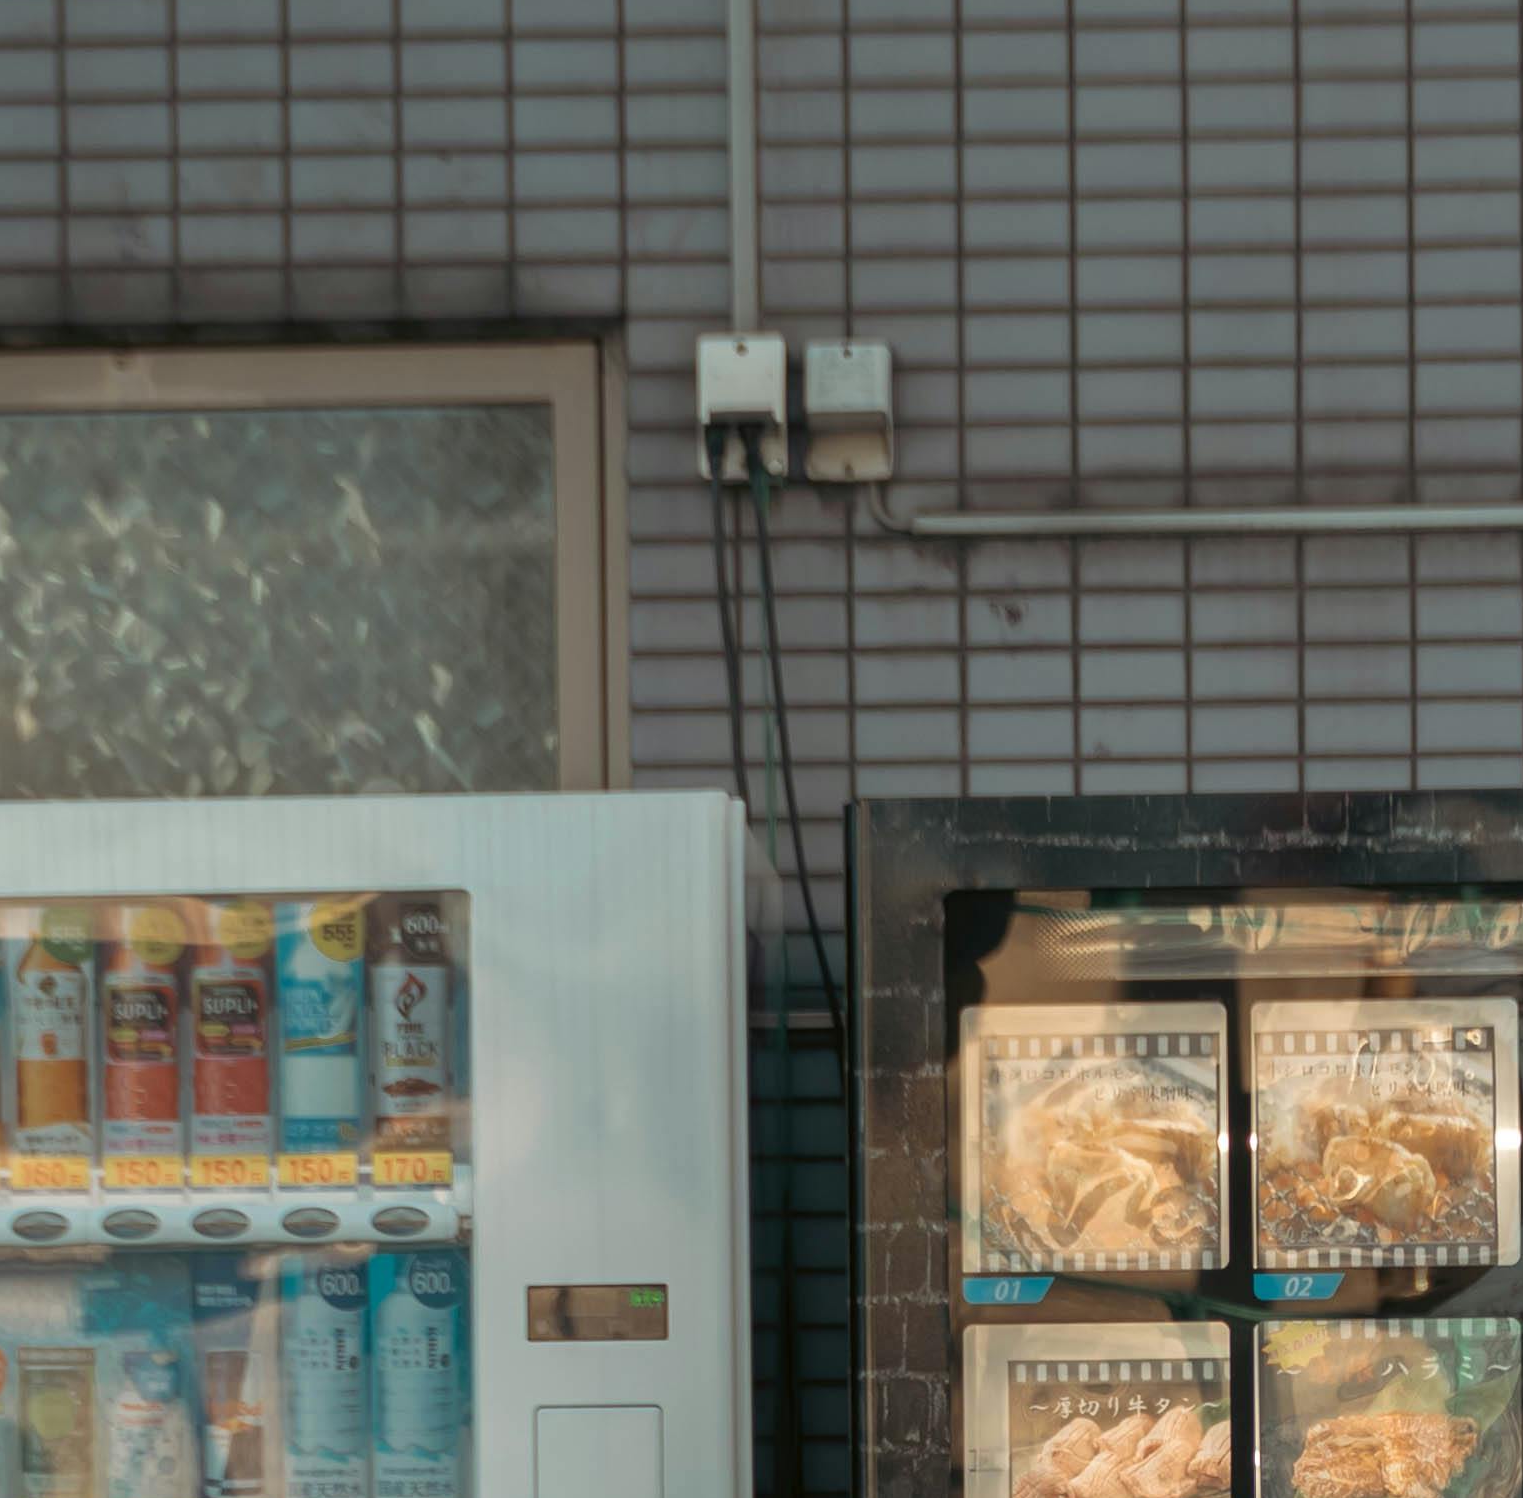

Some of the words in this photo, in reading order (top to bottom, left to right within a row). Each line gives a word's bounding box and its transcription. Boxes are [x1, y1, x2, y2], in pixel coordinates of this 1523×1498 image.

[382, 1157, 445, 1183] 170円
[994, 1280, 1022, 1301] 01
[1285, 1276, 1313, 1297] 02
